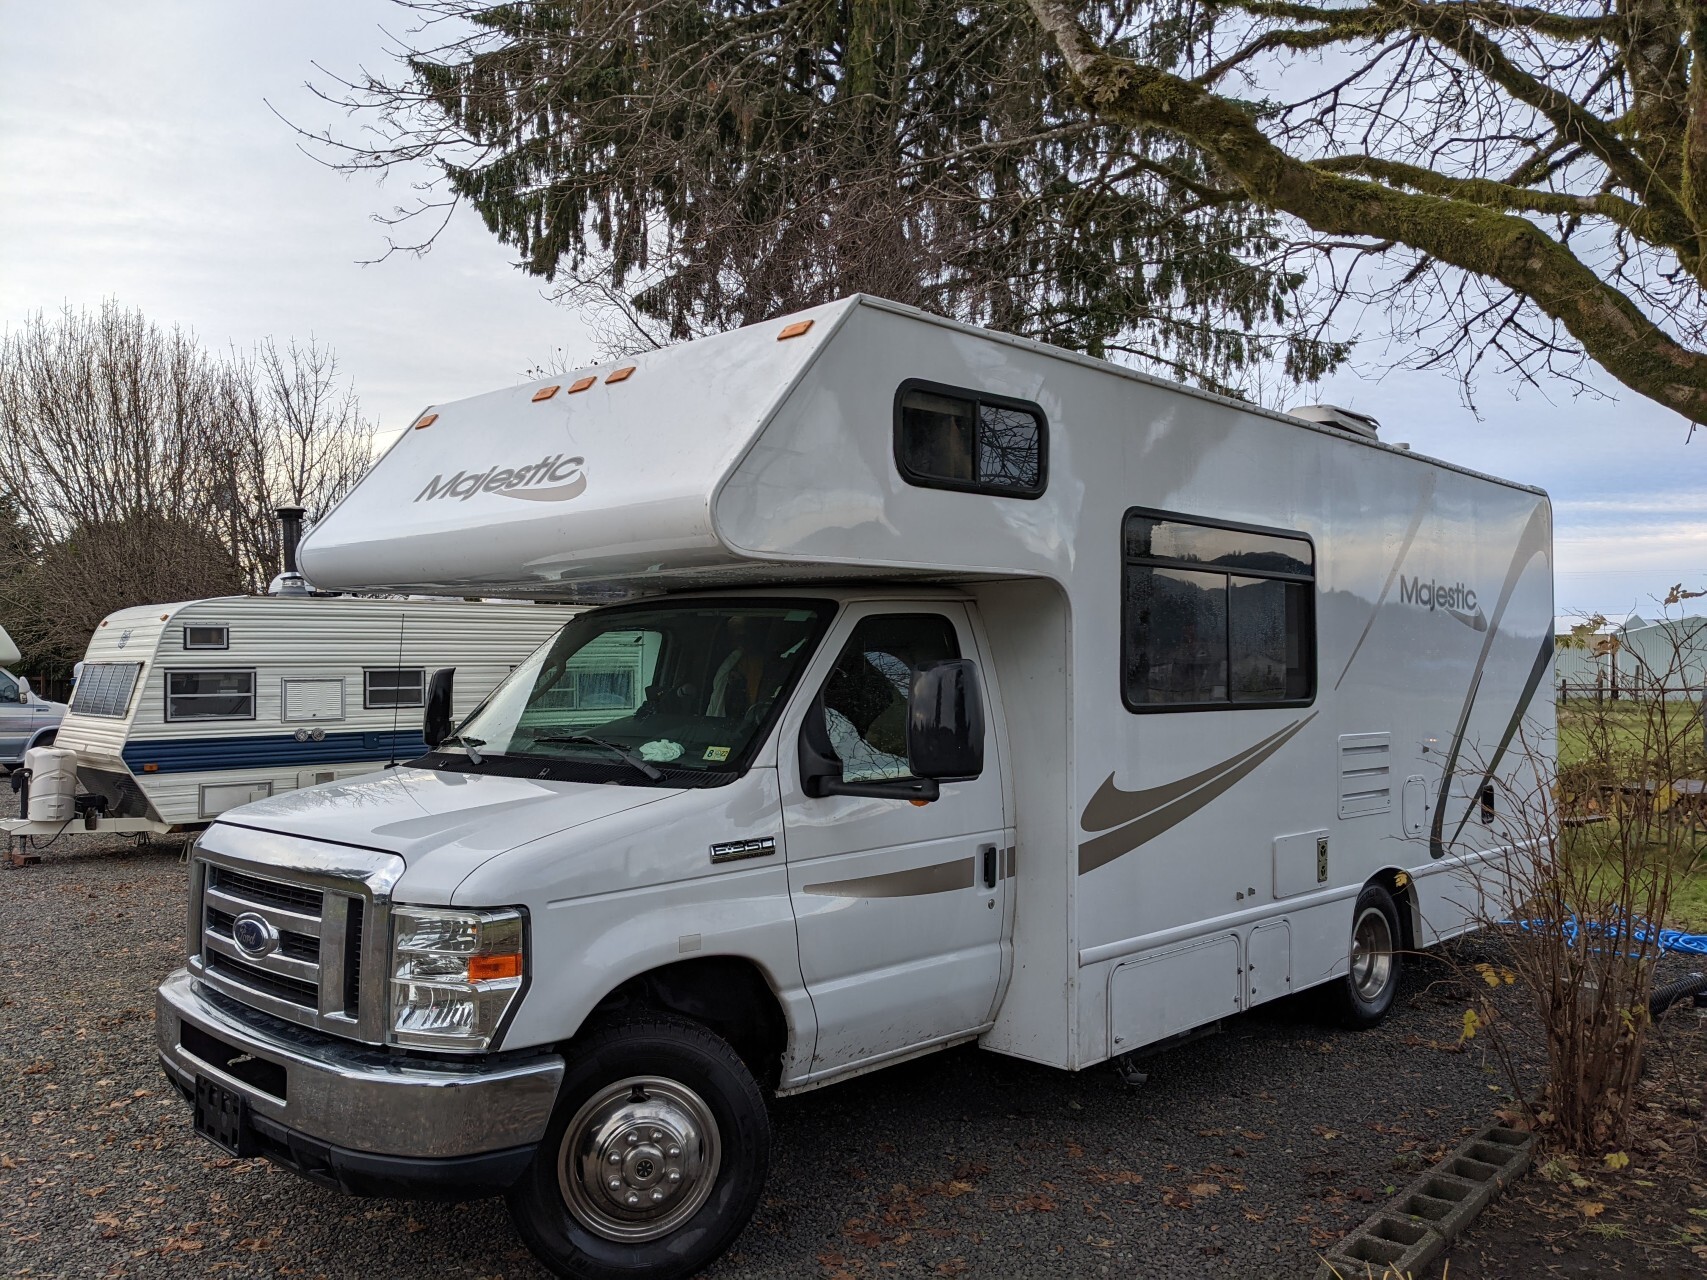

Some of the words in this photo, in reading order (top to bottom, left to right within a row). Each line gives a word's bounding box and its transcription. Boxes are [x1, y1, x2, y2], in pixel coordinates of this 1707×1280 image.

[413, 453, 585, 503] Majestic
[1400, 574, 1477, 612] Majestic
[707, 749, 715, 758] 8
[238, 924, 257, 945] Ford
